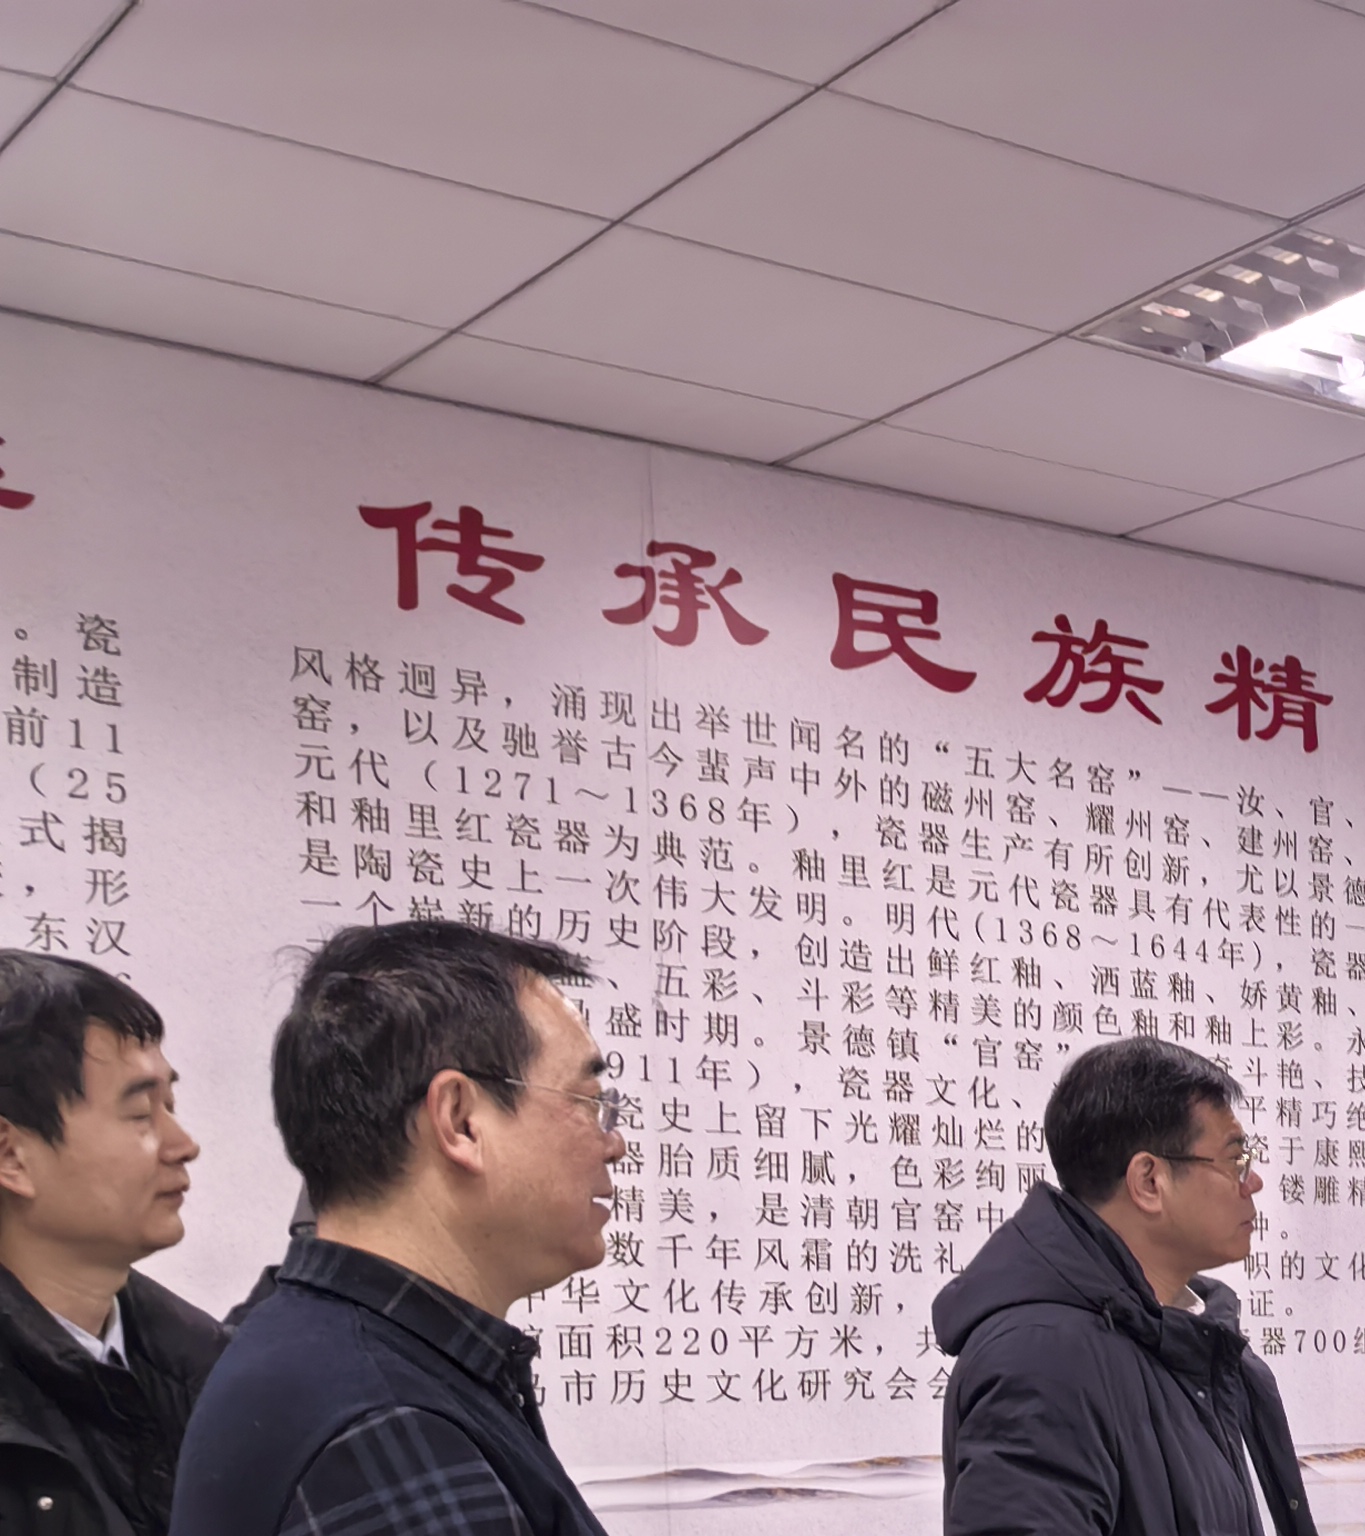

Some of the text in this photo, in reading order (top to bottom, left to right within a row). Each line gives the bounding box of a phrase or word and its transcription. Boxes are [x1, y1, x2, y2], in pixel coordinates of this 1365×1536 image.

[12, 655, 123, 707] 制造
[24, 912, 133, 957] 东汉
[573, 1000, 1070, 1074] 盛时期。景德镇“官窑”
